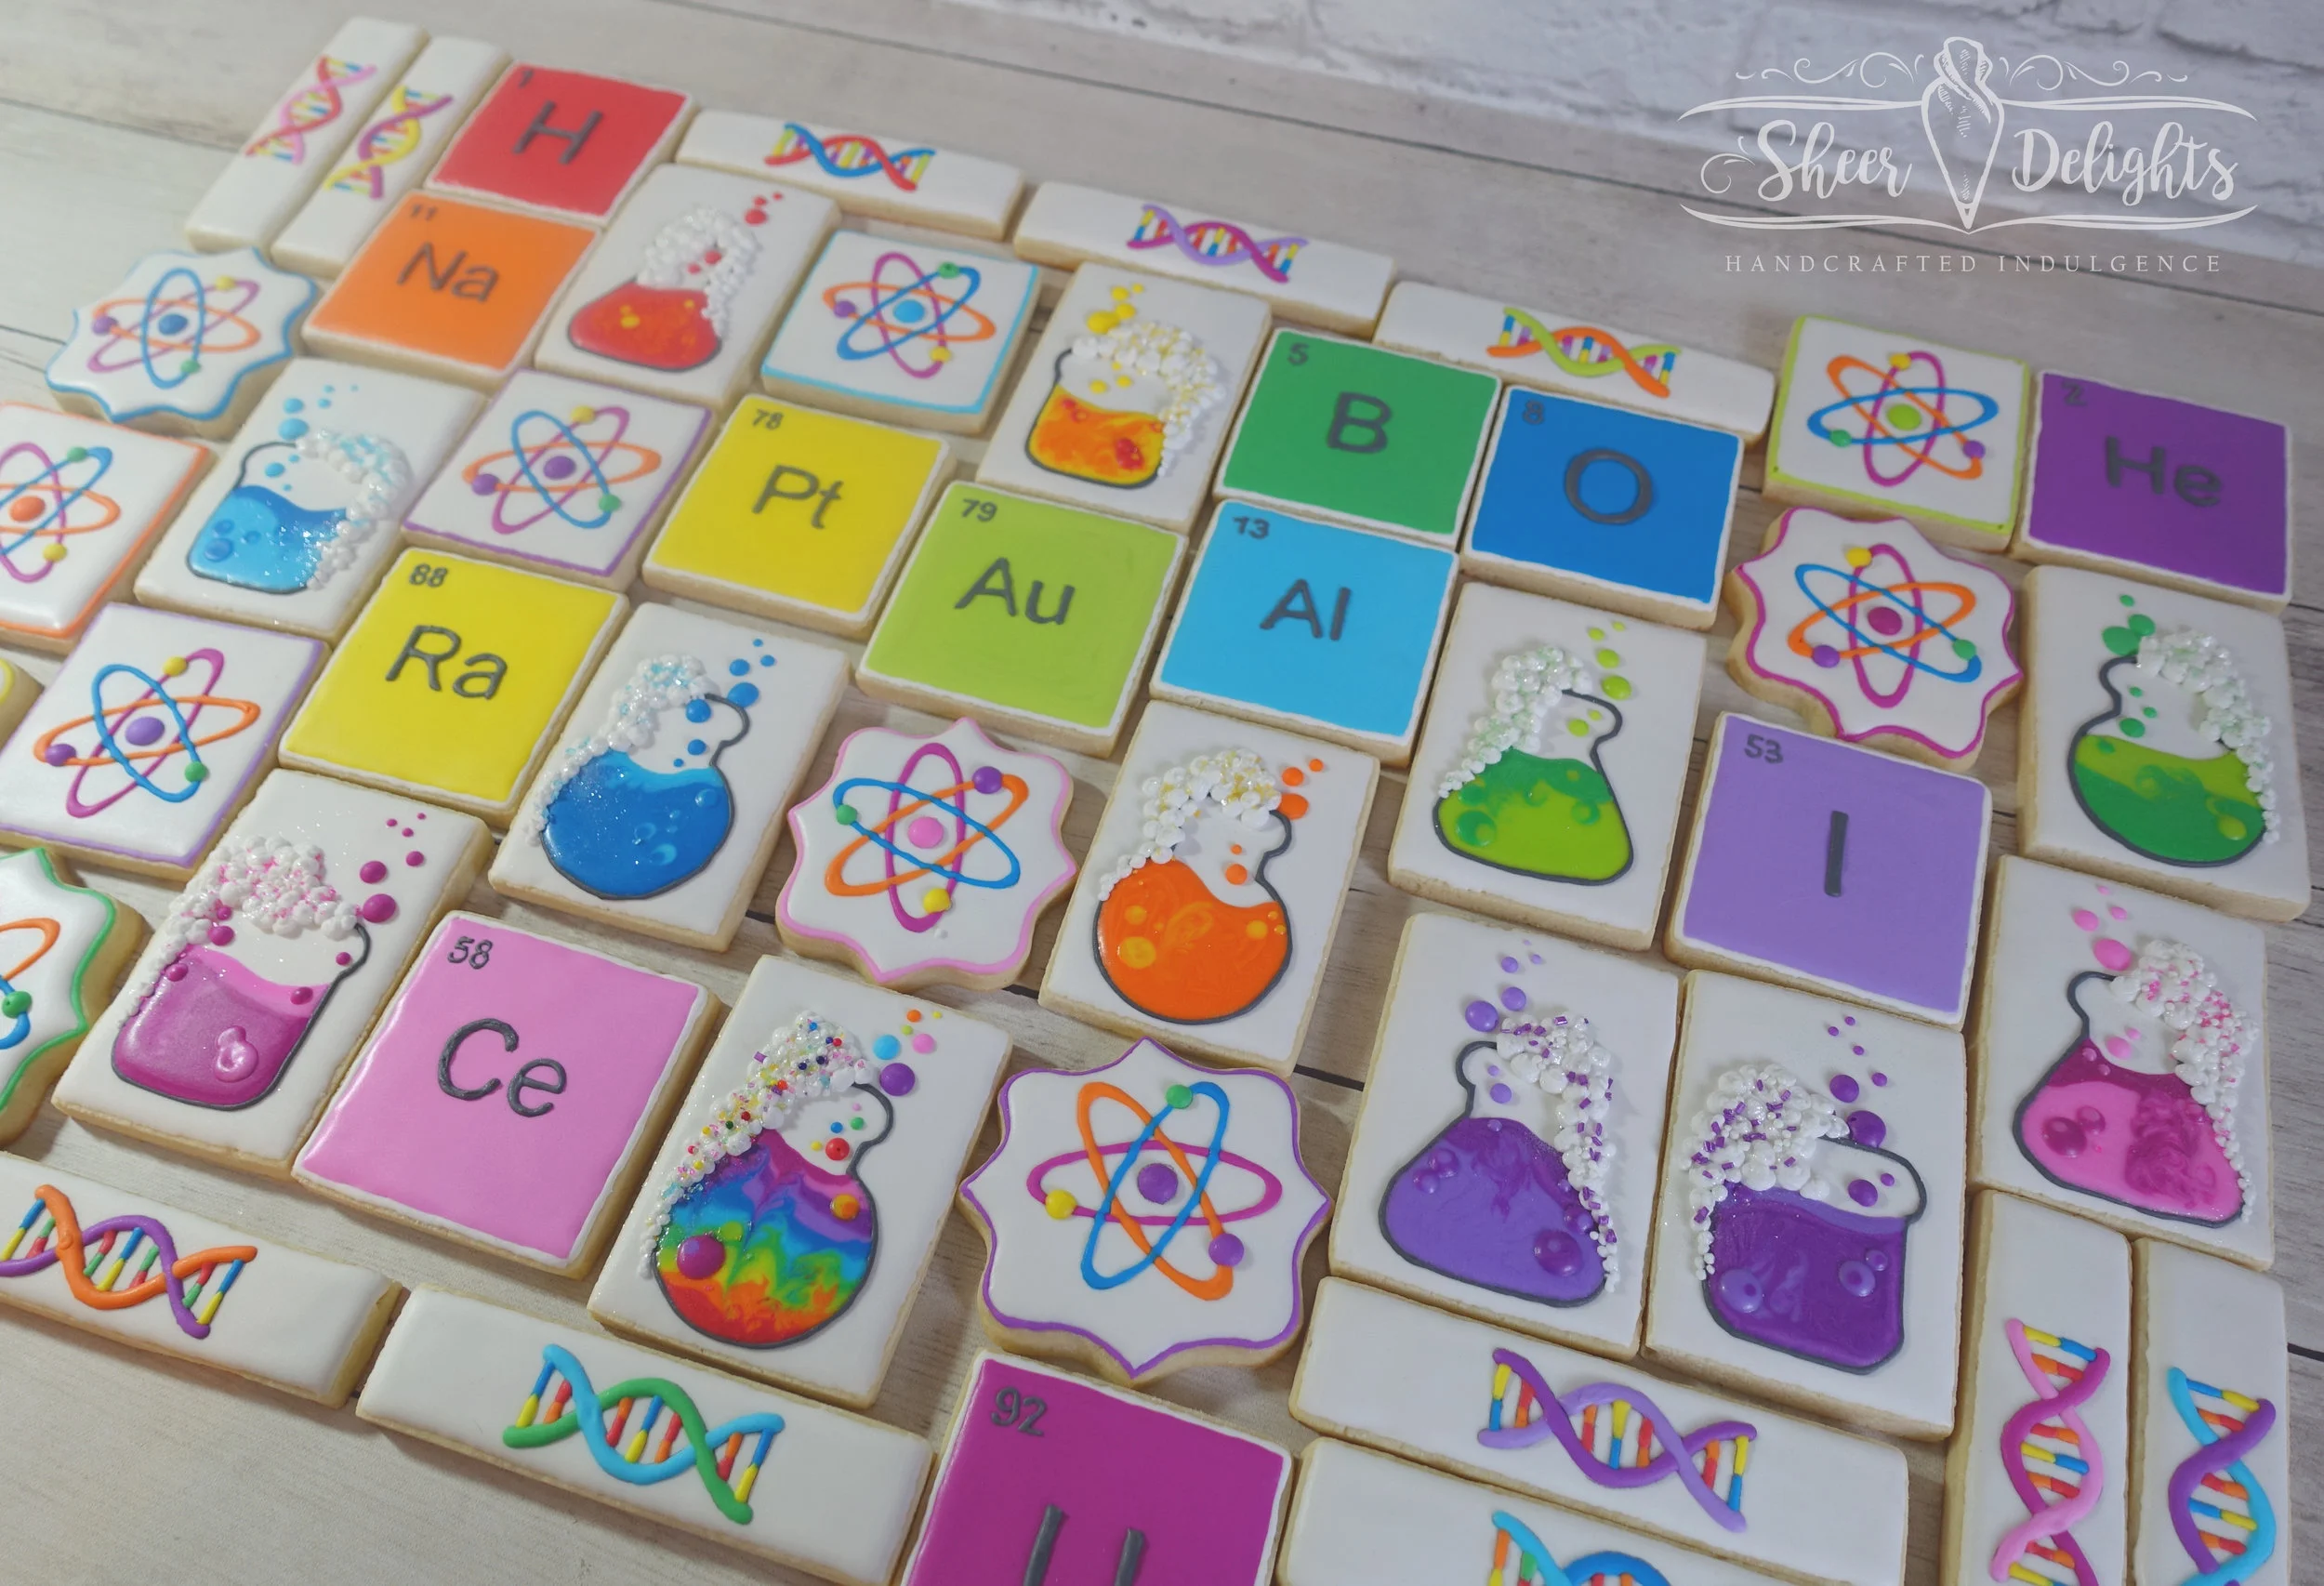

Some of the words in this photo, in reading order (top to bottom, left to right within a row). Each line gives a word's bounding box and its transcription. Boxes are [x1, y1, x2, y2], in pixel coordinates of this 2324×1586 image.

[513, 100, 603, 165] H
[397, 242, 499, 302] Na
[1287, 343, 1310, 365] 5
[752, 409, 783, 431] 78
[1327, 391, 1392, 454] B
[1523, 400, 1545, 425] 8
[2061, 381, 2087, 406] 2
[752, 465, 843, 530] Pt
[1564, 447, 1654, 525] O
[2106, 436, 2223, 507] He
[961, 499, 997, 522] 79
[1232, 515, 1270, 539] 13
[408, 563, 448, 588] 88
[954, 557, 1076, 625] Au
[1259, 578, 1352, 641] Al
[385, 625, 508, 700] Ra
[1744, 734, 1784, 764] 53
[1824, 810, 1849, 897] I
[447, 935, 494, 970] 58
[437, 1018, 567, 1117] Ce
[991, 1386, 1047, 1436] 92
